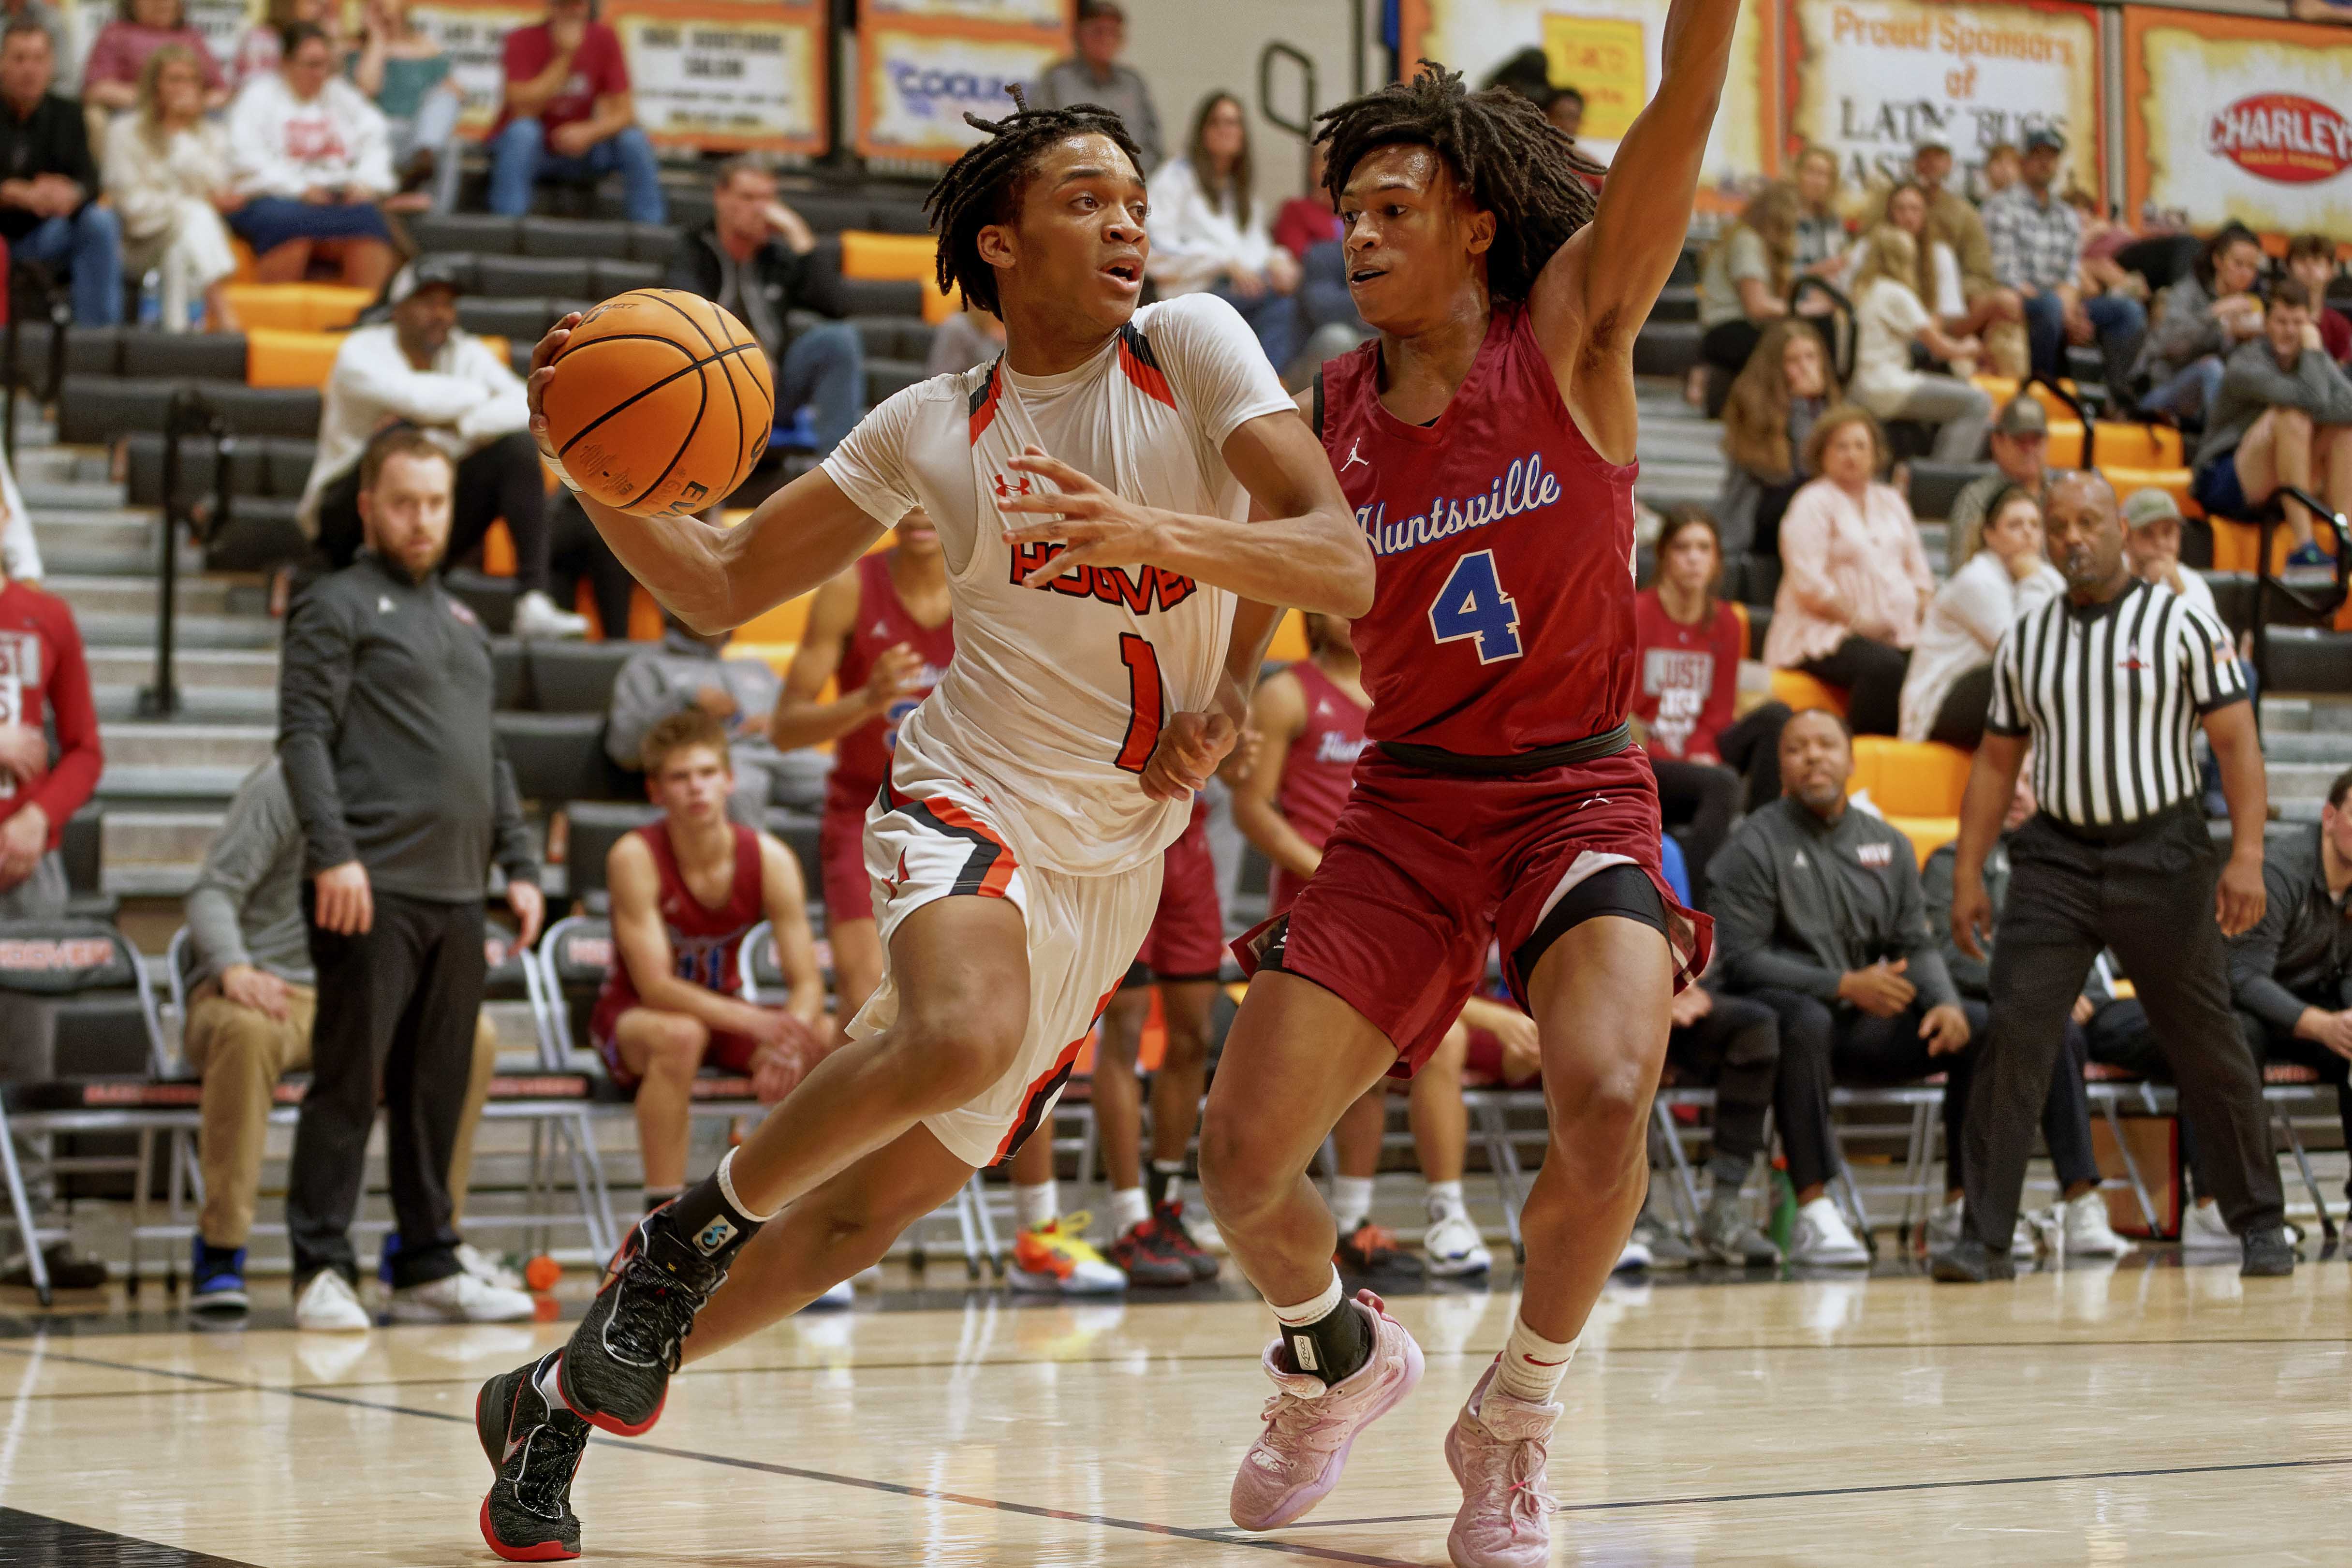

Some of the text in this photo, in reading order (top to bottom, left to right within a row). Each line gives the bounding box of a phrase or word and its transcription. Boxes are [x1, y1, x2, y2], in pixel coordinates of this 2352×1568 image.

[1833, 6, 2075, 67] Proud Sponsors
[1944, 62, 1978, 99] of
[2205, 104, 2352, 161] CHARLEY
[1355, 451, 1562, 557] Huntsville
[1009, 539, 1198, 616] HOOVE
[1427, 548, 1524, 665] 4
[1113, 631, 1164, 775] 1
